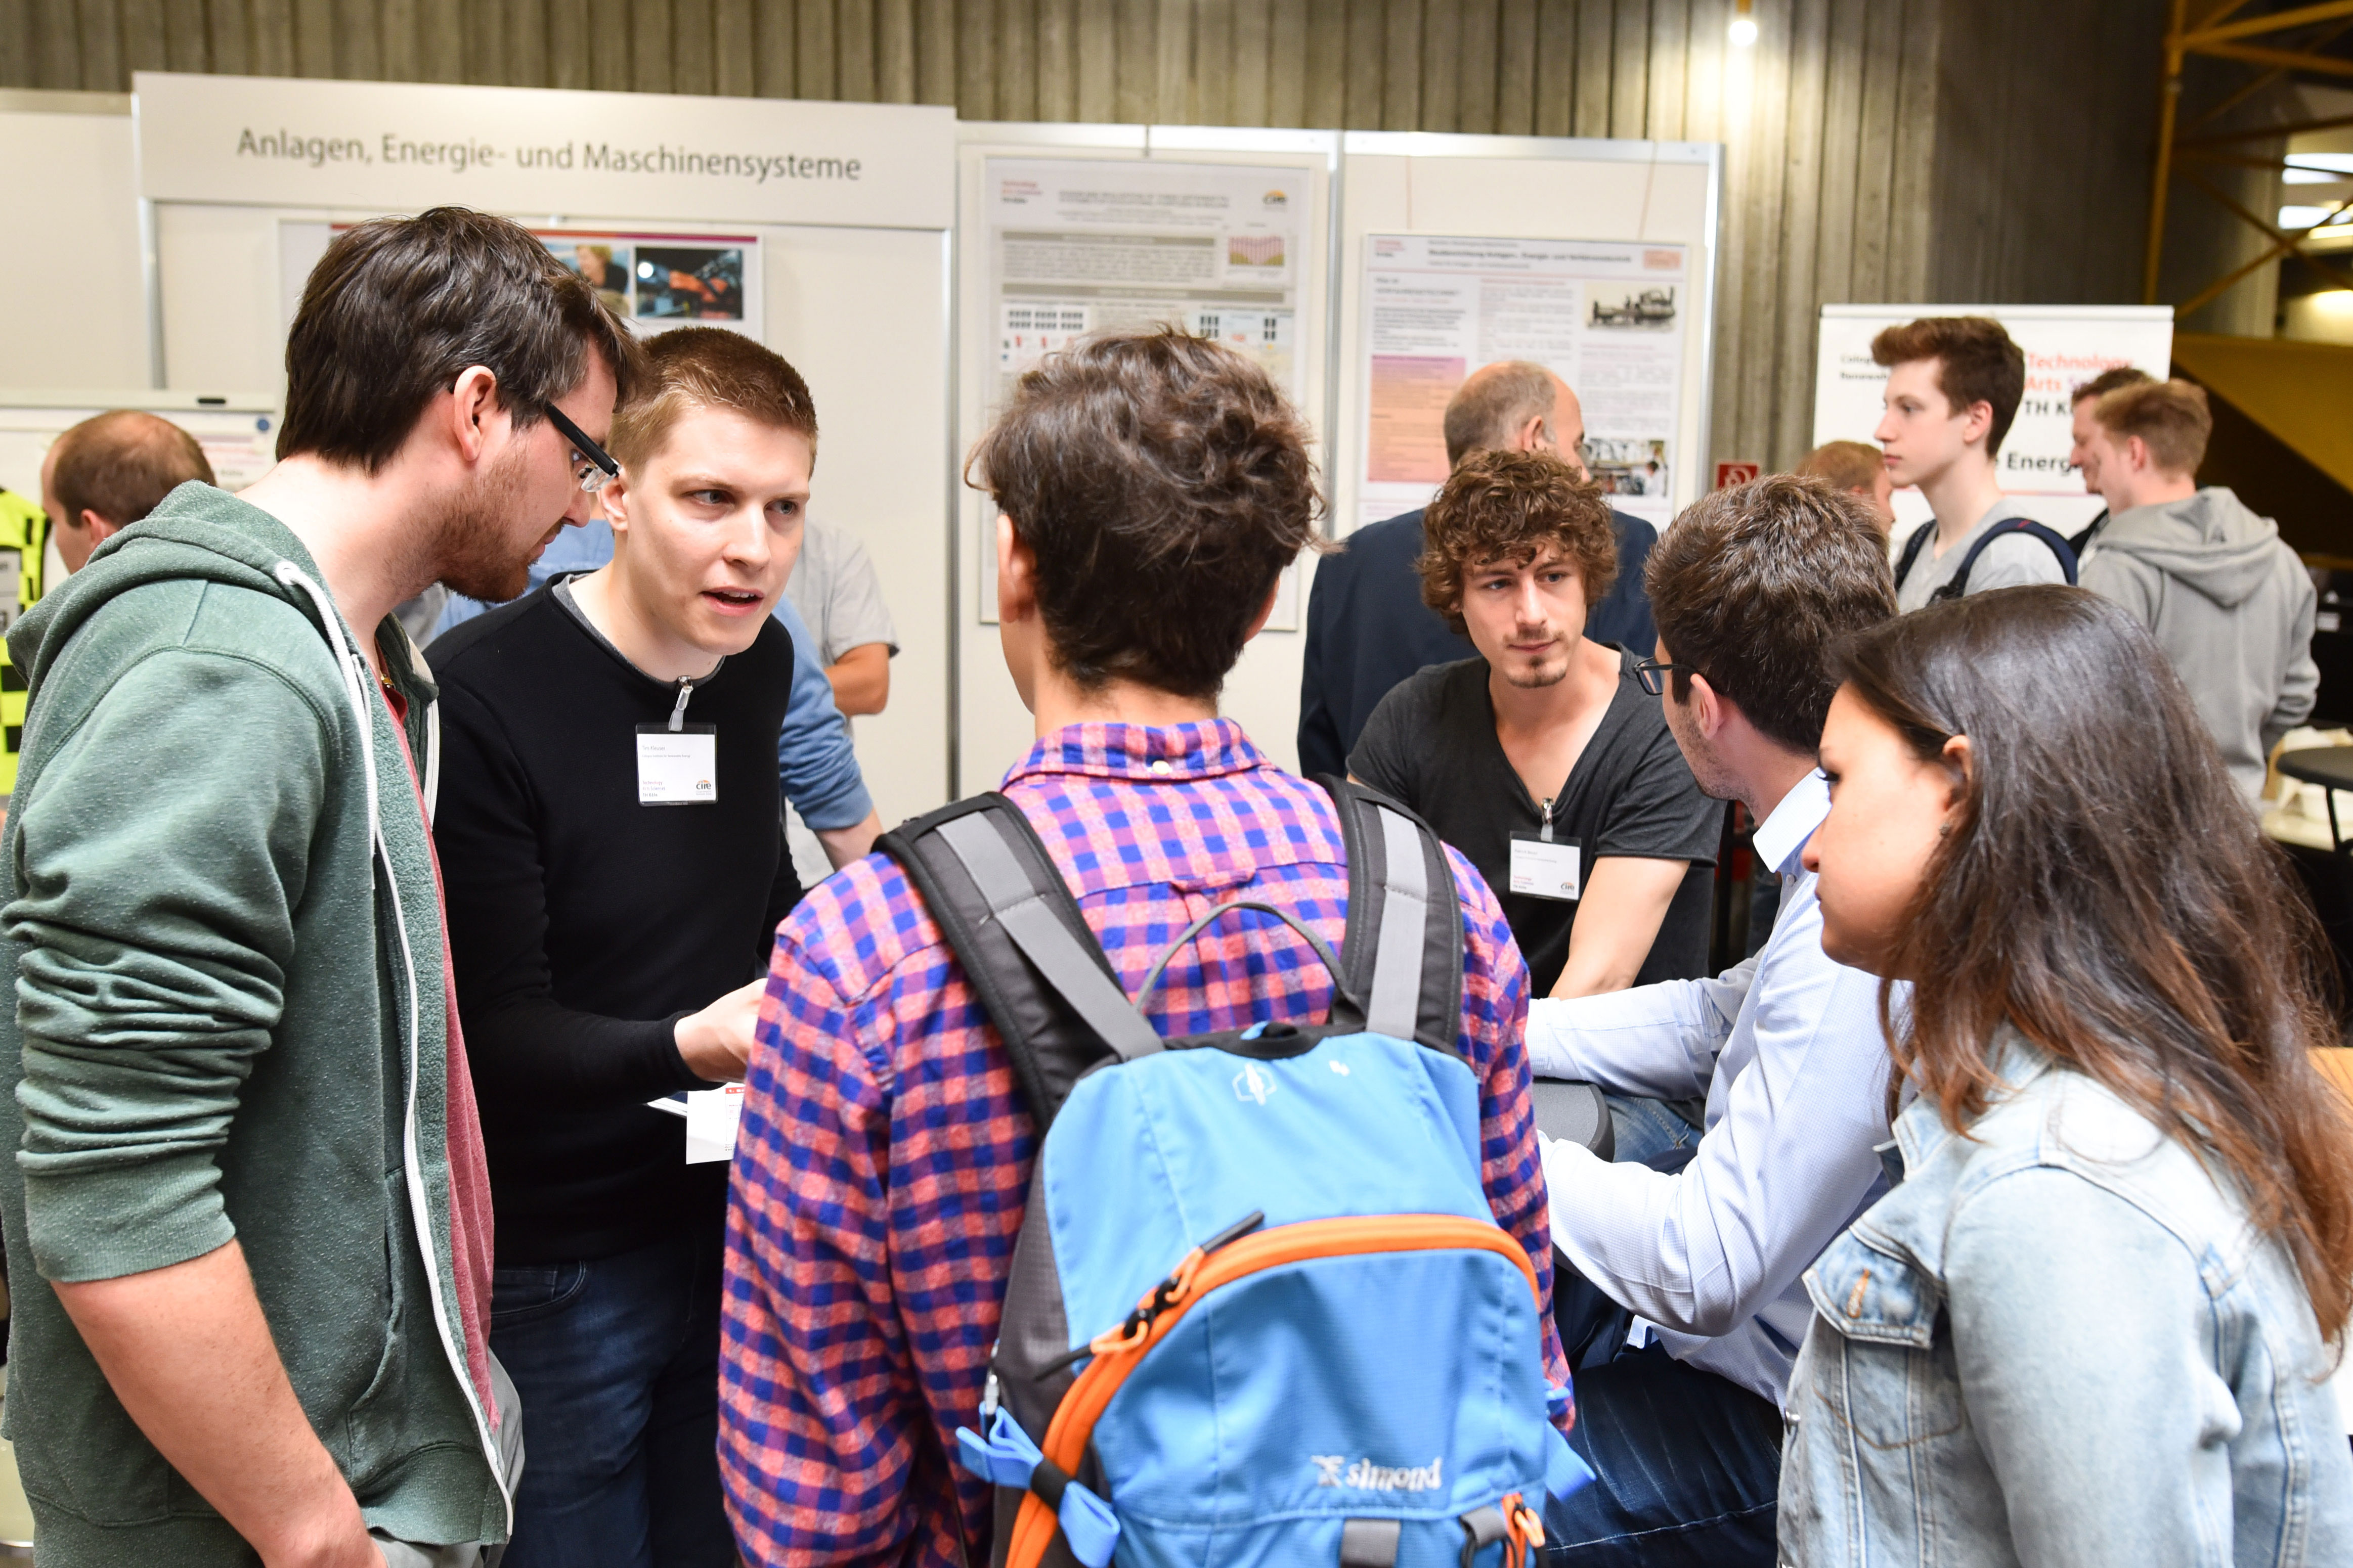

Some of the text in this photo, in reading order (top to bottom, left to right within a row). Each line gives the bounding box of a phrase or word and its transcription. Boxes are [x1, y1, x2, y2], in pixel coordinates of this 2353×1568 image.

[238, 127, 861, 184] Anlagen, Energie- und Maschinensysteme
[2024, 377, 2061, 392] Arts
[2025, 401, 2073, 416] TH K
[2008, 454, 2077, 475] Energ
[1346, 1457, 1443, 1492] simond
